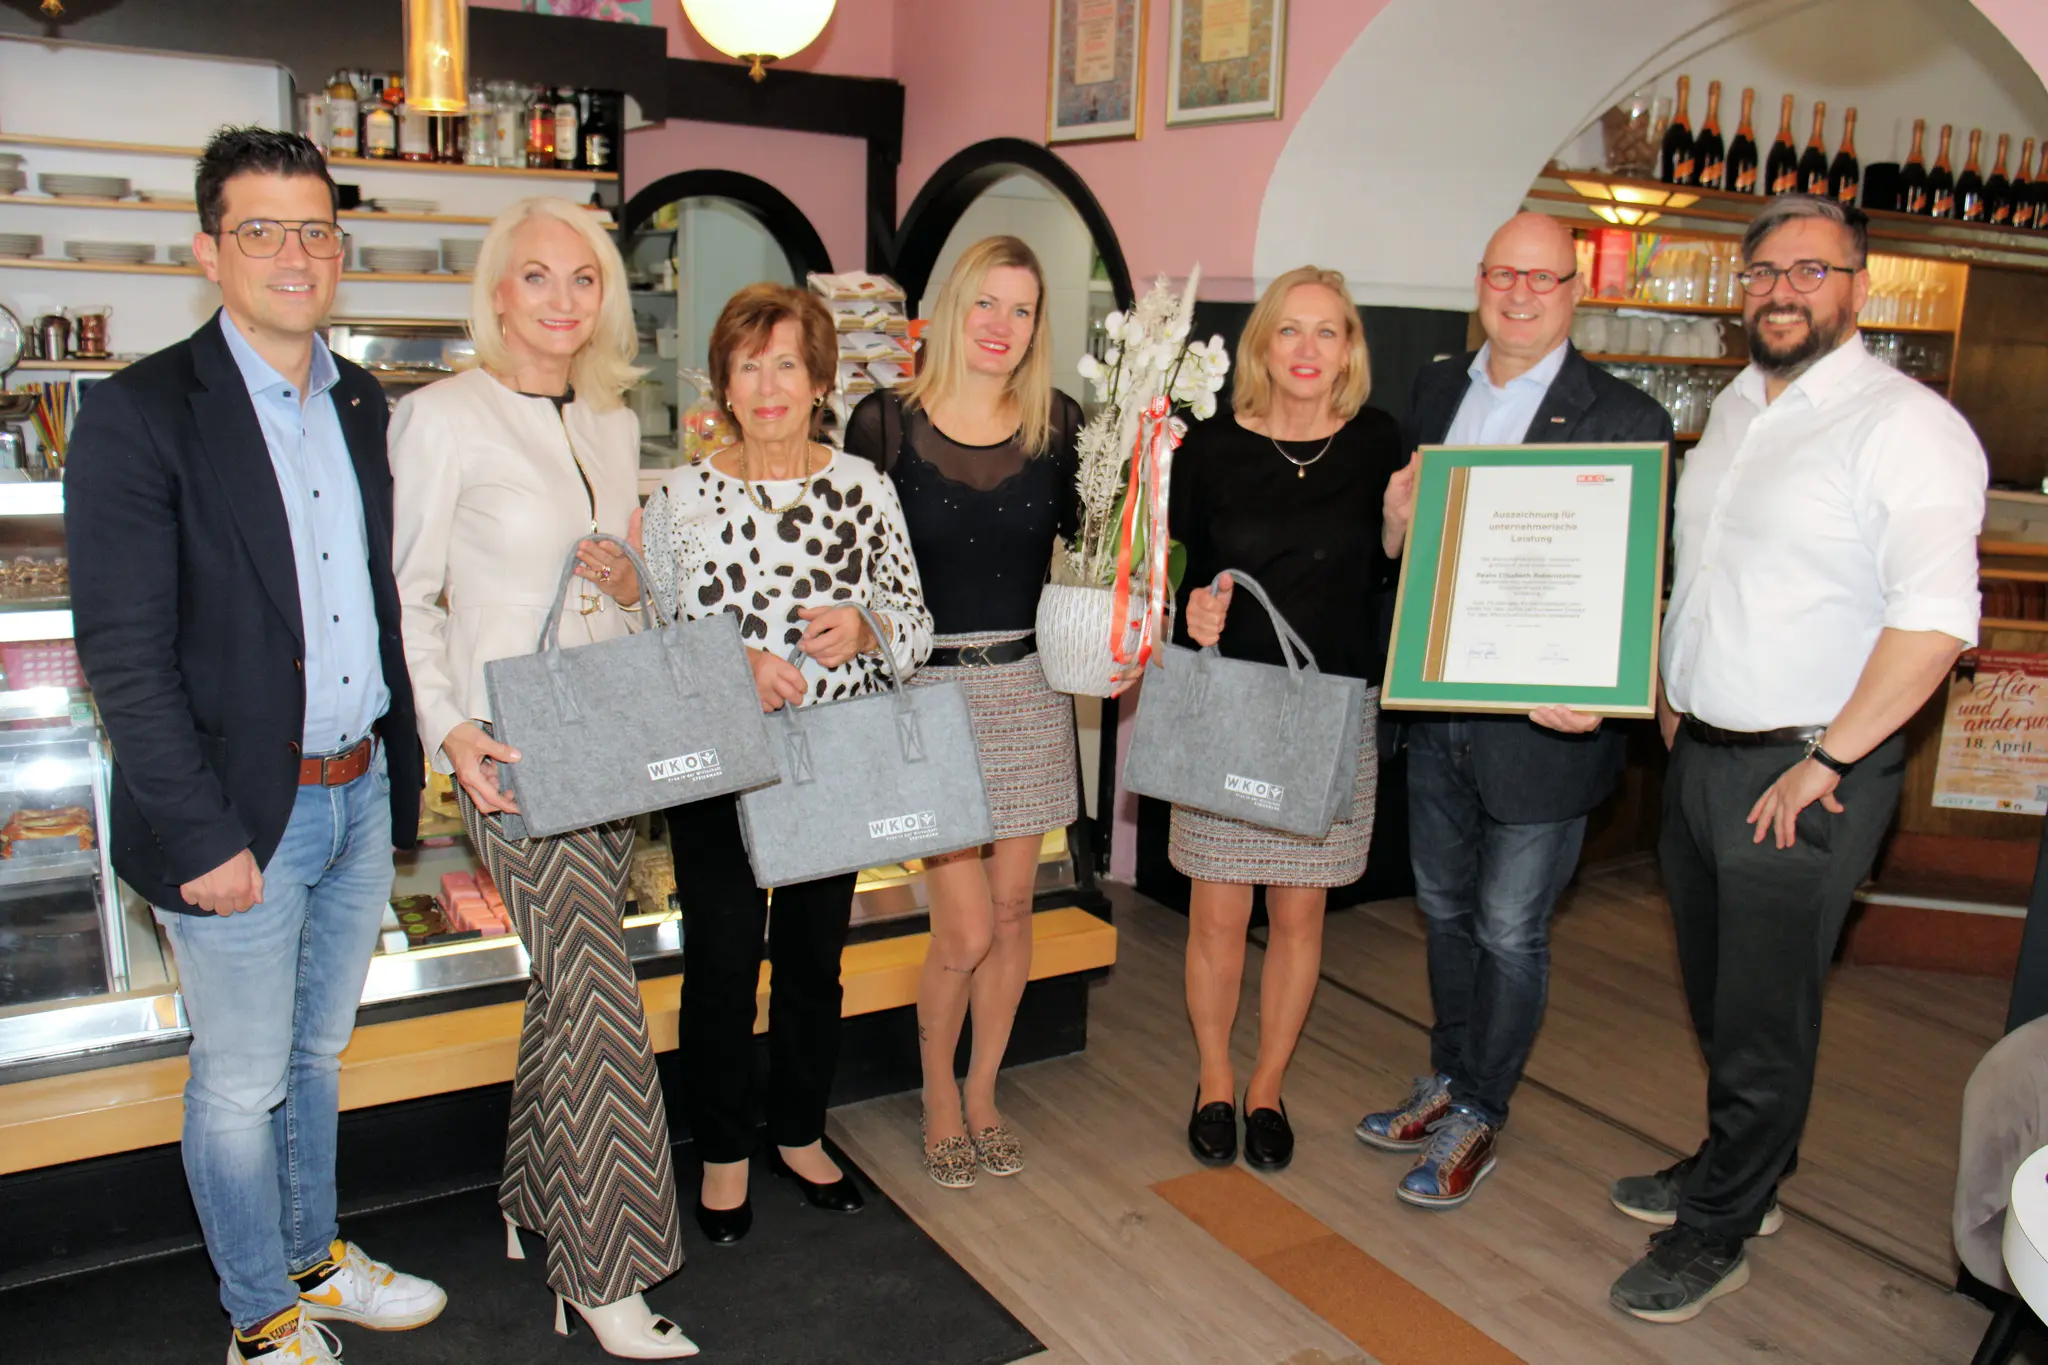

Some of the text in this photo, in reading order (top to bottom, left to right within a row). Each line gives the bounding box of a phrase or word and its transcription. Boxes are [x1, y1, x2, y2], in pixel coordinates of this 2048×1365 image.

[1492, 510, 1576, 521] Auszeichnung für
[1489, 523, 1578, 531] unternehmerische
[1511, 535, 1552, 544] Leistung
[1971, 671, 2040, 705] Hier
[1958, 695, 1998, 717] und
[1963, 709, 2048, 732] andersw
[1966, 737, 2032, 753] 18. April
[649, 755, 699, 779] WKO
[1226, 775, 1267, 796] WKO
[870, 815, 917, 836] WKO
